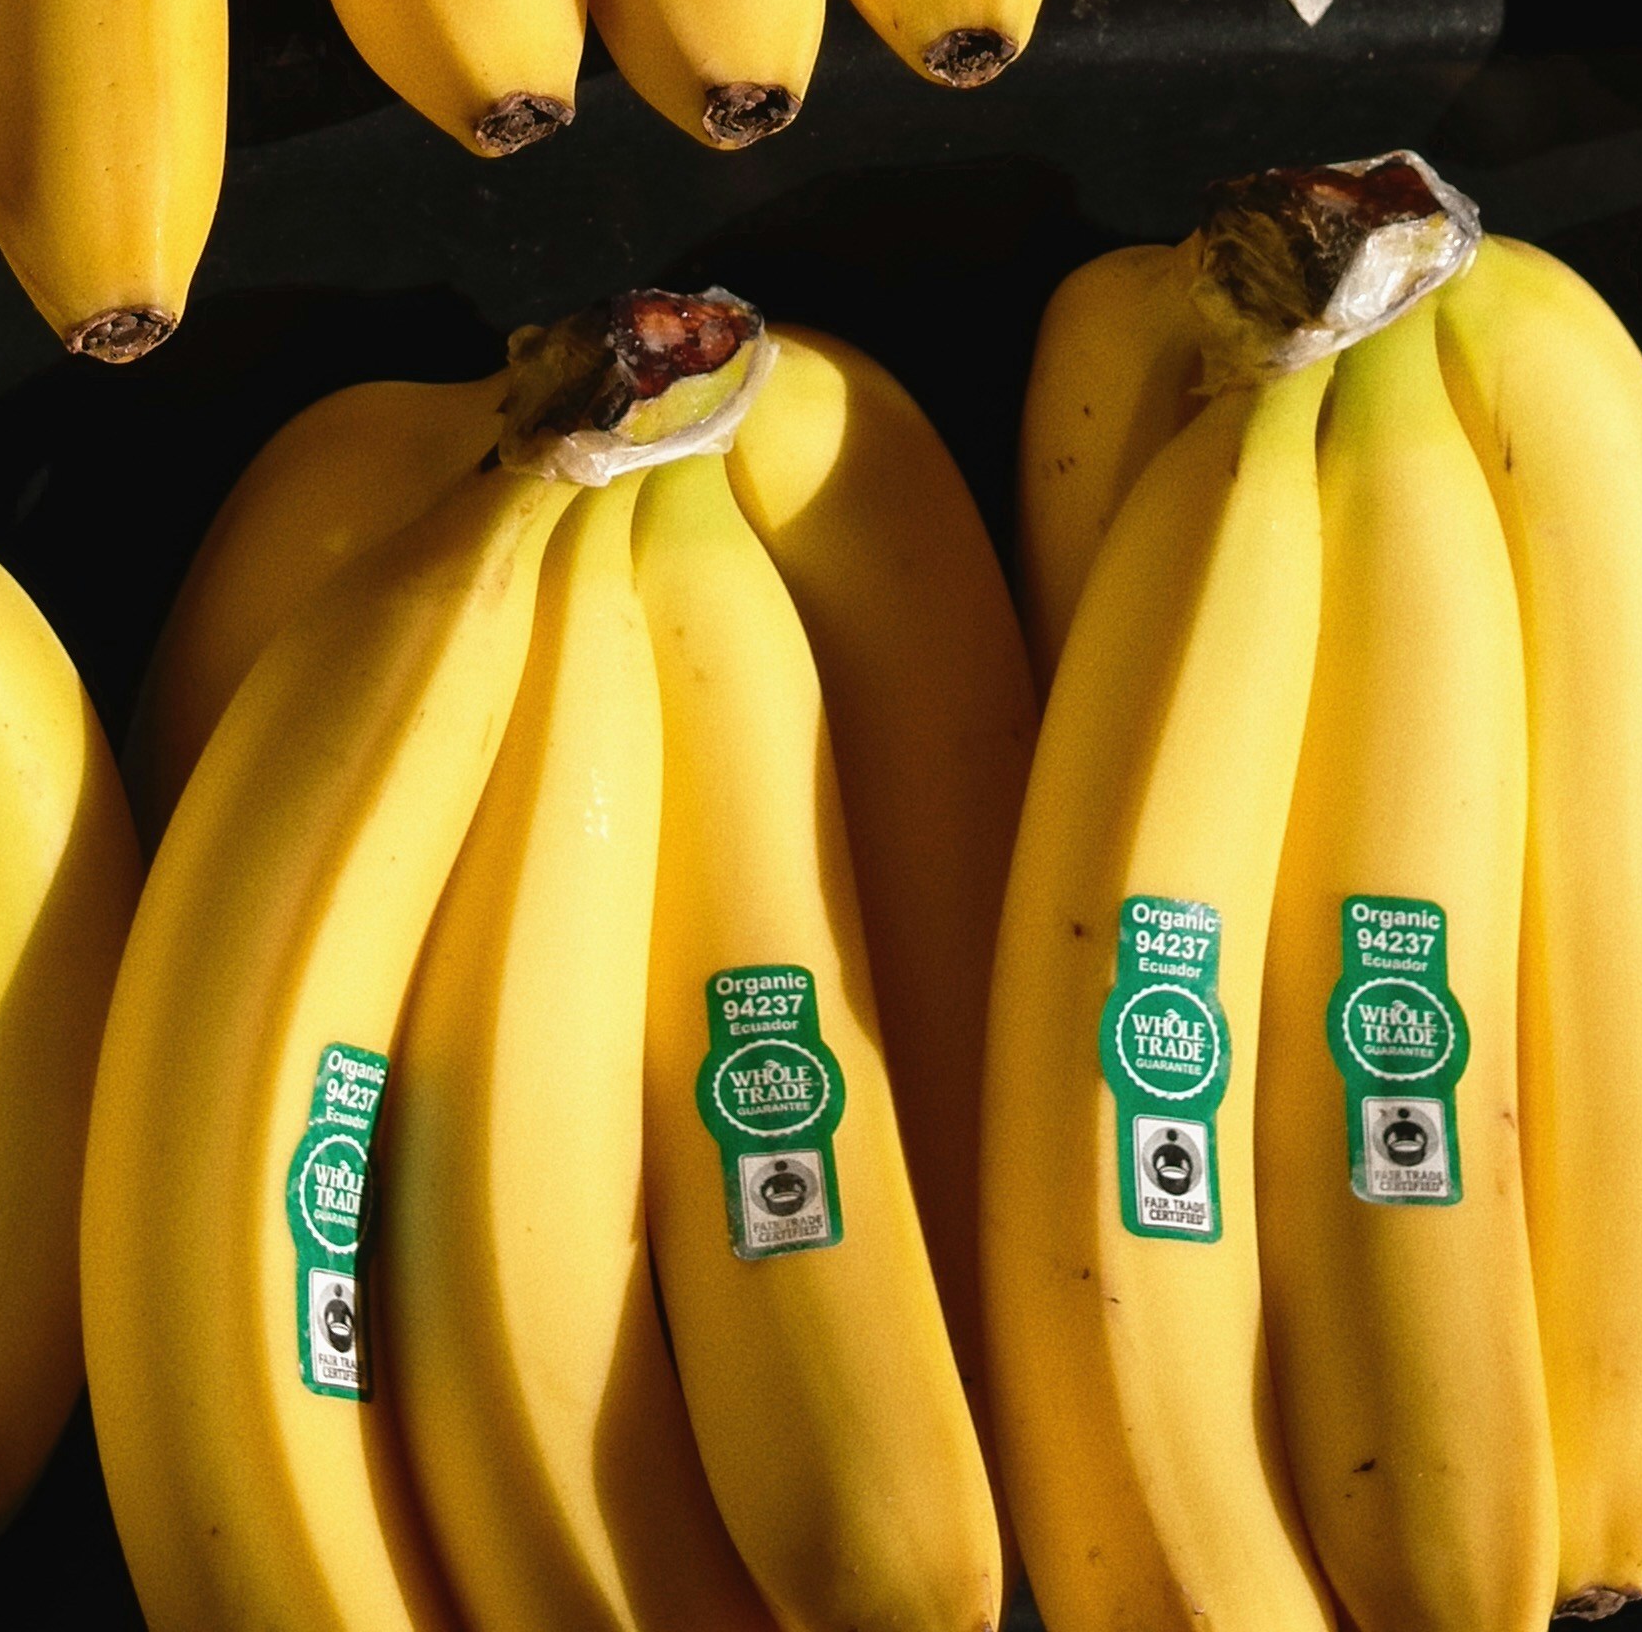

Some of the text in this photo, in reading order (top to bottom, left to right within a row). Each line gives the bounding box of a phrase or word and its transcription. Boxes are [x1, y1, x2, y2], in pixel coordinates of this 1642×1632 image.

[1132, 903, 1217, 933] Organic
[1351, 903, 1440, 930] Organic
[1135, 930, 1209, 961] 94237
[1357, 928, 1436, 956] 94237
[1138, 957, 1202, 980] Ecuador
[1362, 953, 1427, 972] Ecuador
[716, 972, 808, 996] Organic
[723, 994, 803, 1020] 94237
[1359, 1002, 1437, 1028] WHOLE
[729, 1019, 799, 1036] Ecuador
[1131, 1012, 1206, 1042] WHOLE
[1361, 1023, 1438, 1046] TRADE
[1134, 1035, 1205, 1063] TRADE
[1363, 1044, 1435, 1058] GUARANTEE
[327, 1051, 385, 1085] Organic
[729, 1064, 813, 1088] WHOLE
[1135, 1057, 1202, 1075] GUARANTEE
[326, 1078, 379, 1113] 94237
[733, 1083, 813, 1106] TRADE
[326, 1106, 370, 1131] Ecuador
[737, 1102, 811, 1116] GUARANTEE
[1404, 1171, 1442, 1183] TRADE
[1145, 1196, 1205, 1214] FAIR TRADE
[753, 1215, 823, 1234] FAIR TRADE
[1149, 1209, 1203, 1225] CERTIFIED
[319, 1352, 337, 1366] FAIR
